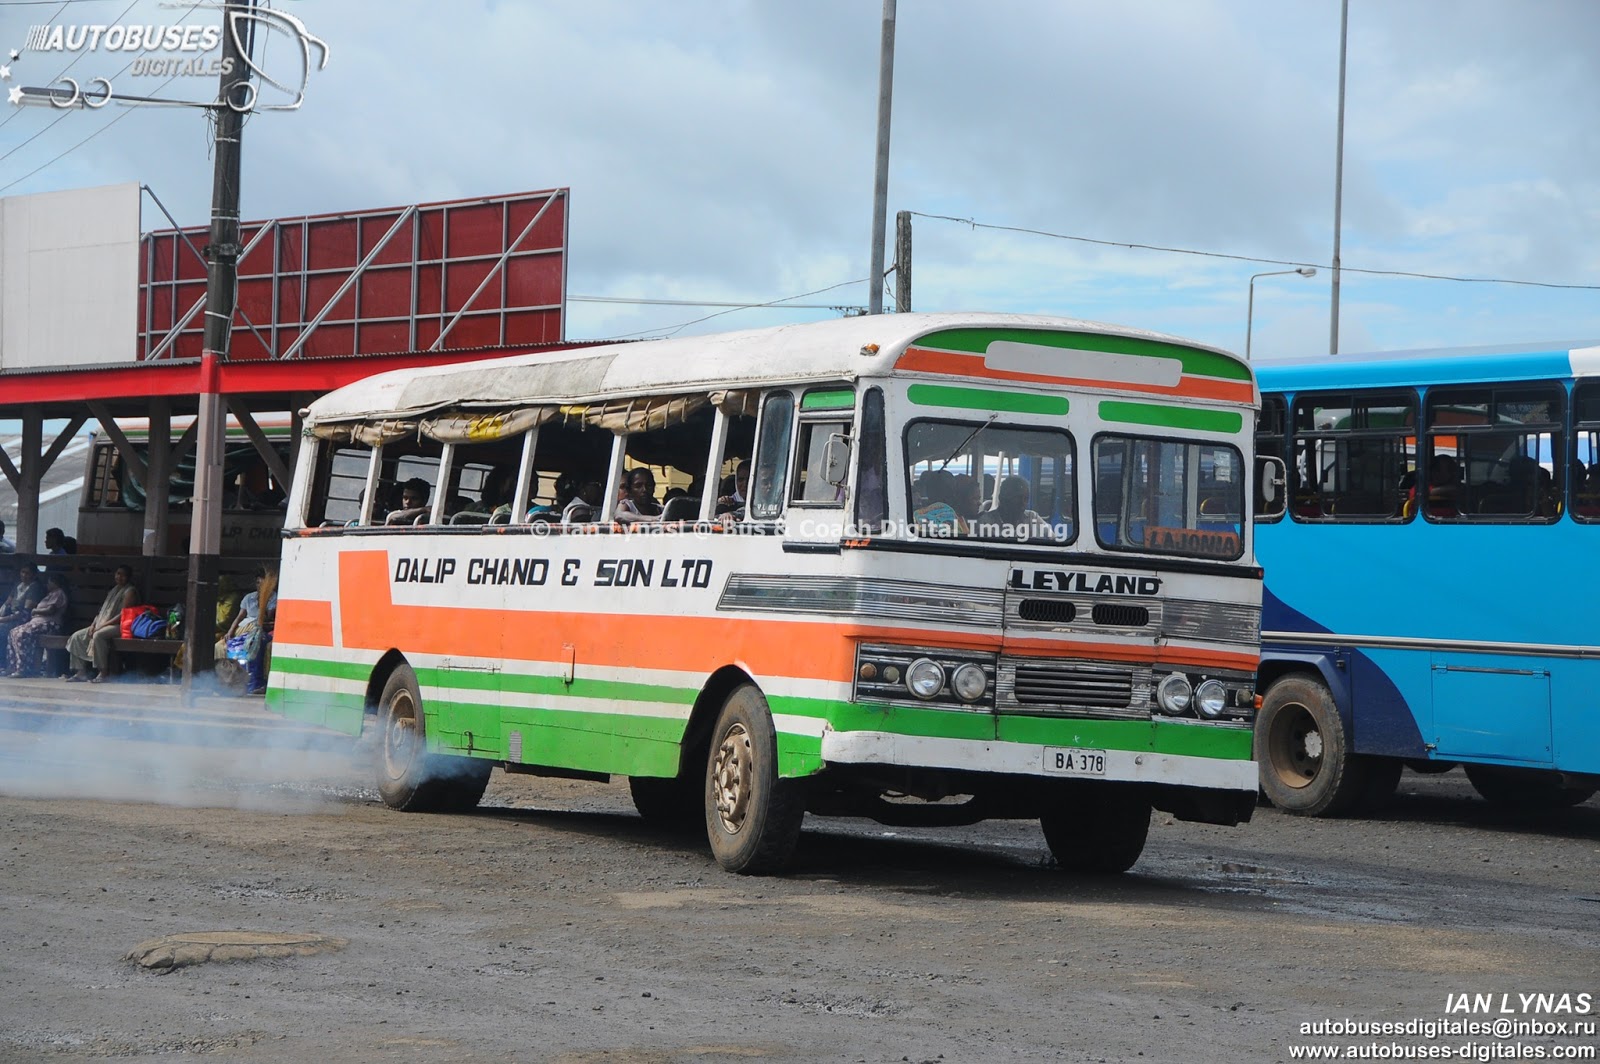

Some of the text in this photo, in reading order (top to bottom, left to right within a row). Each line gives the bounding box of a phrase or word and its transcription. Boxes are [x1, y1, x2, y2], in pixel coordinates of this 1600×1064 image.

[394, 558, 713, 588] DALIP CHAND & SON LTD
[1011, 569, 1160, 595] LEYLAND
